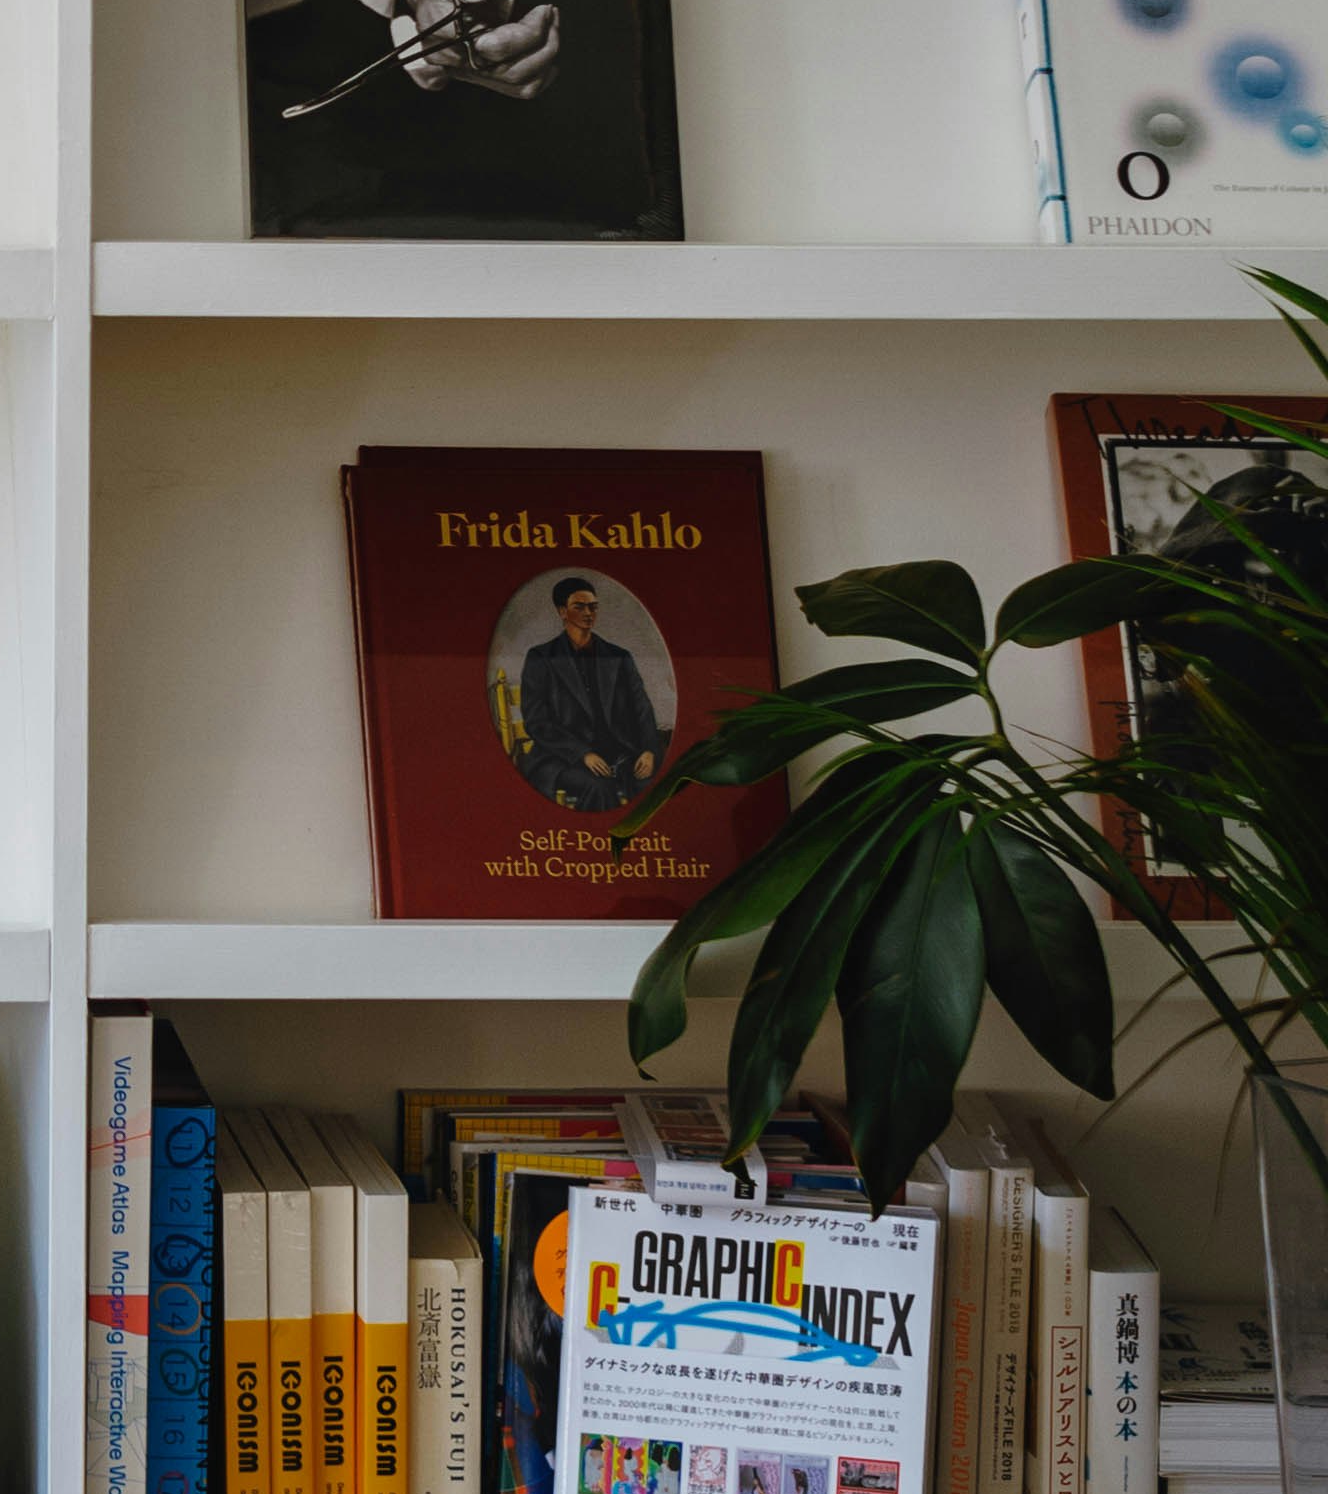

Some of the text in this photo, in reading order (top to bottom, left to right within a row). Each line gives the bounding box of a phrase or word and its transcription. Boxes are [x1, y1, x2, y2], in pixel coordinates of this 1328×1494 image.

[1088, 217, 1211, 236] PHAIDON
[437, 513, 702, 550] Frida Kahlo
[484, 856, 710, 884] with Cropped Hair
[109, 1057, 130, 1177] Videogame
[112, 1184, 129, 1235] Atlas
[108, 1251, 129, 1345] Mapping
[799, 1283, 916, 1358] INDEX
[109, 1351, 128, 1455] Interactive
[447, 1434, 465, 1482] FUJI
